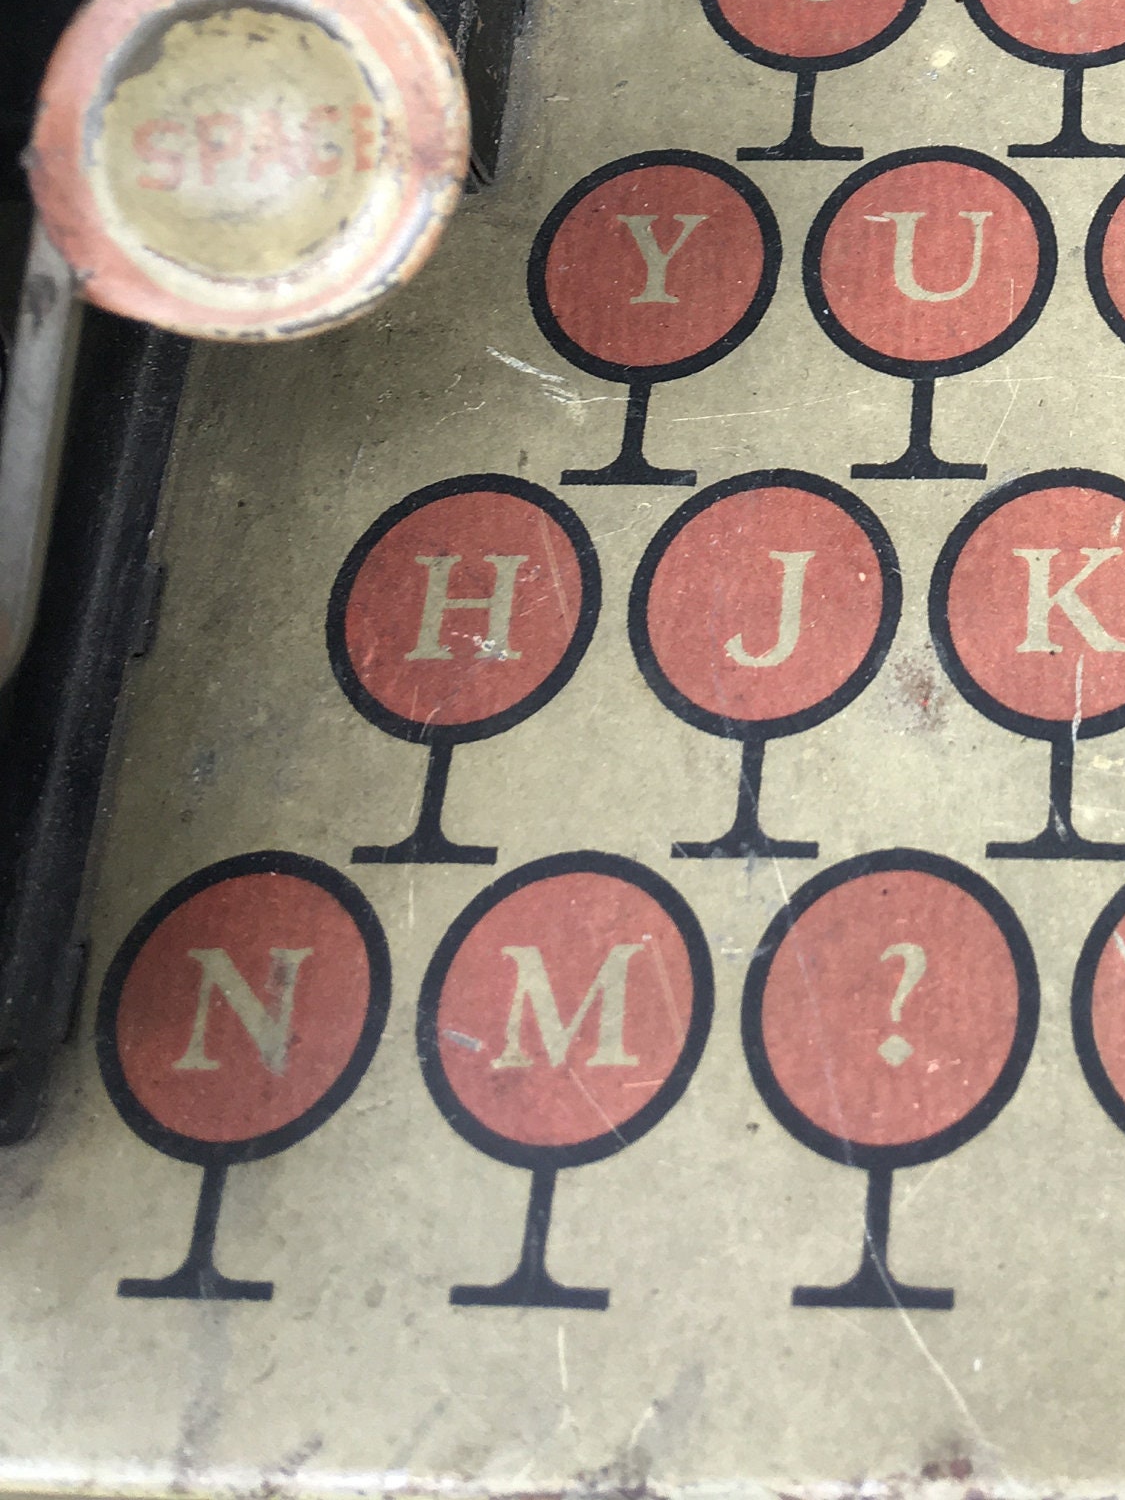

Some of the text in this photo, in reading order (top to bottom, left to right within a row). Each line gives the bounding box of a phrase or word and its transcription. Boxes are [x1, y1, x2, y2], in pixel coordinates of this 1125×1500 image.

[132, 102, 378, 192] SPACE
[617, 214, 709, 304] Y
[881, 210, 993, 302] U
[405, 554, 529, 661] H
[724, 550, 816, 667] J
[171, 947, 314, 1077] N
[491, 942, 645, 1068] M
[880, 942, 928, 1067] ?
